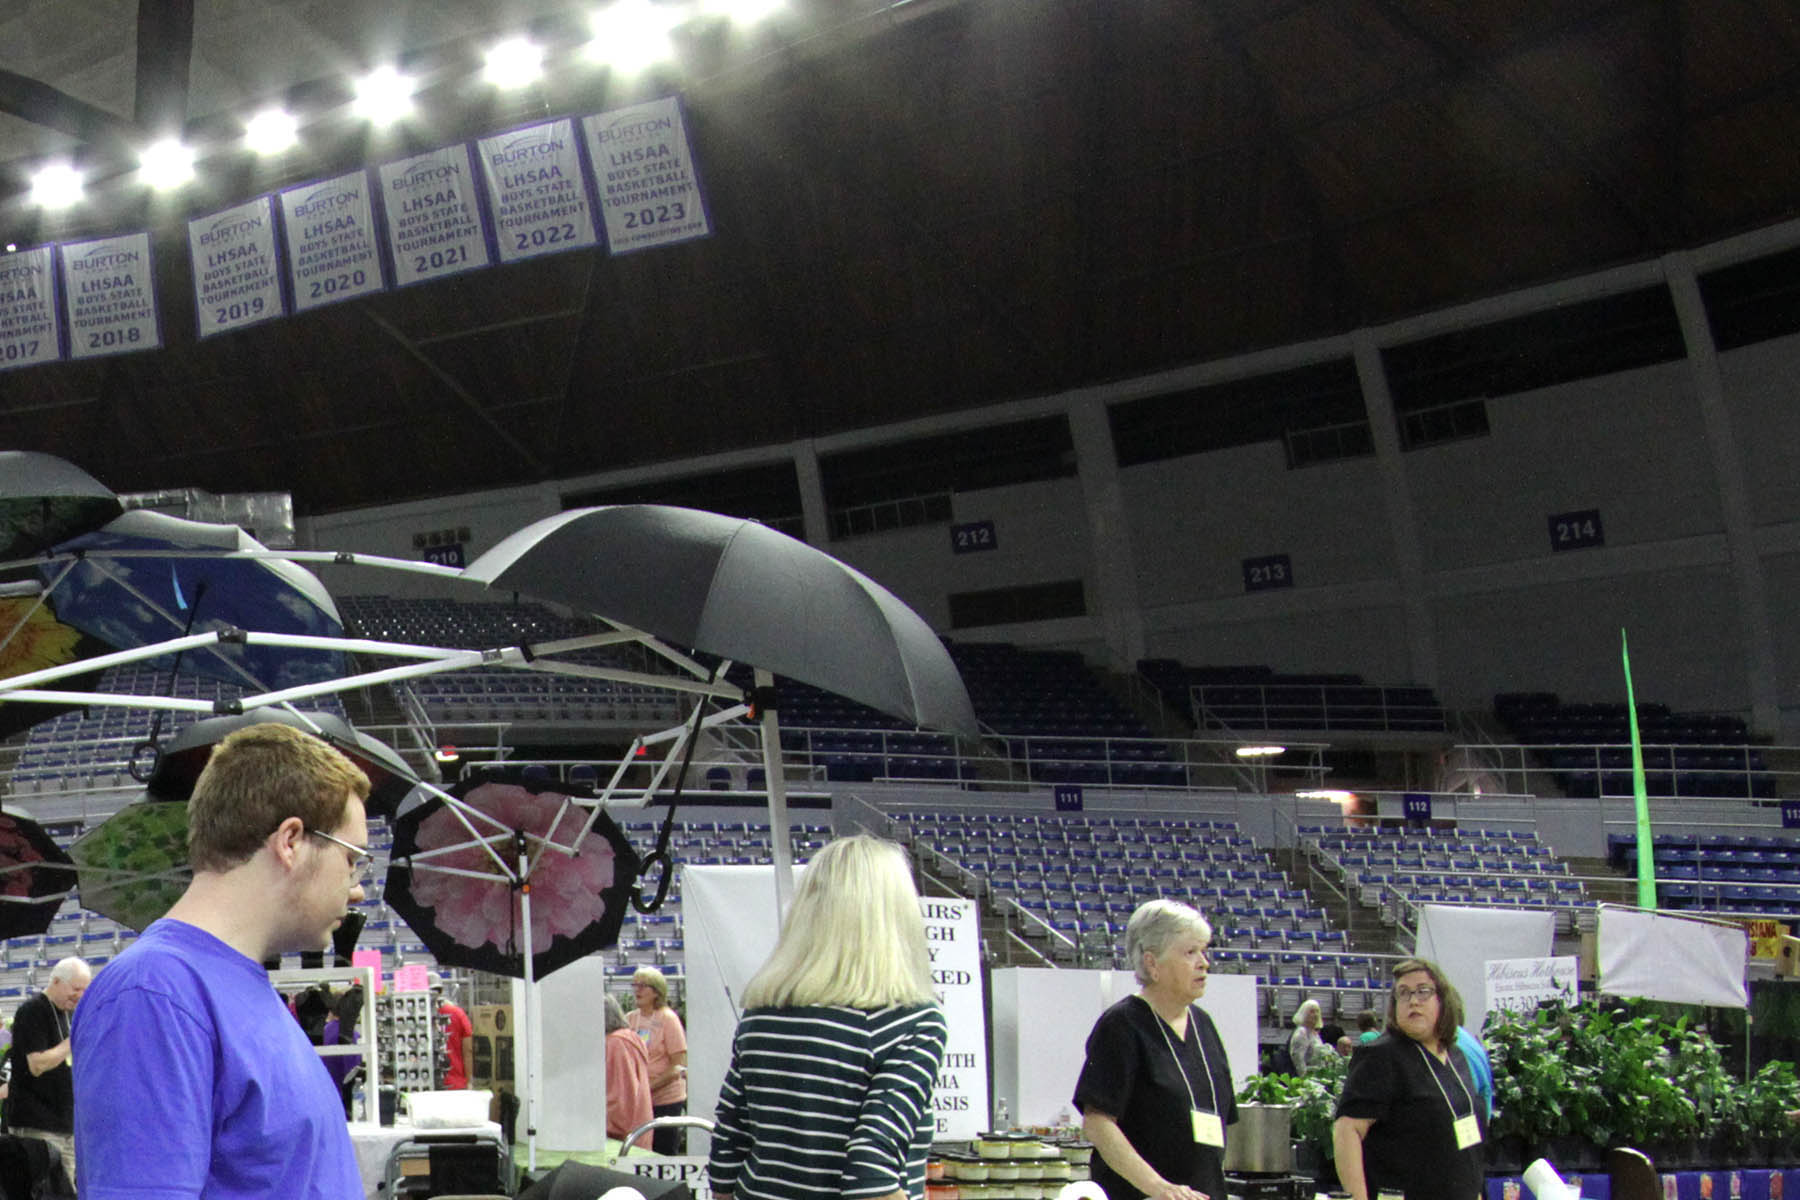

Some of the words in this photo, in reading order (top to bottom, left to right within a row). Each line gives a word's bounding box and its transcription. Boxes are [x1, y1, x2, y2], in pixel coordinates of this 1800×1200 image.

[598, 117, 671, 143] BURTON
[493, 140, 563, 166] BURTON
[611, 144, 669, 166] LHSAA
[392, 163, 459, 190] BURTON
[504, 166, 562, 188] LHSAA
[295, 190, 359, 217] BURTON
[403, 189, 457, 213] LHSAA
[304, 215, 355, 239] LHSAA
[624, 203, 685, 228] 2023
[200, 217, 261, 245] BURTON
[516, 224, 576, 250] 2022
[73, 251, 139, 270] BURTON
[208, 243, 258, 267] LHSAA
[415, 245, 467, 272] 2021
[82, 274, 134, 293] LHSAA
[310, 270, 365, 298] 2020
[216, 297, 264, 323] 2019
[89, 328, 140, 348] 2018
[958, 528, 989, 546] 212
[1557, 520, 1595, 541] 214
[430, 551, 458, 564] 210
[1251, 564, 1284, 583] 213
[1061, 793, 1078, 803] 111
[1409, 801, 1427, 811] 112
